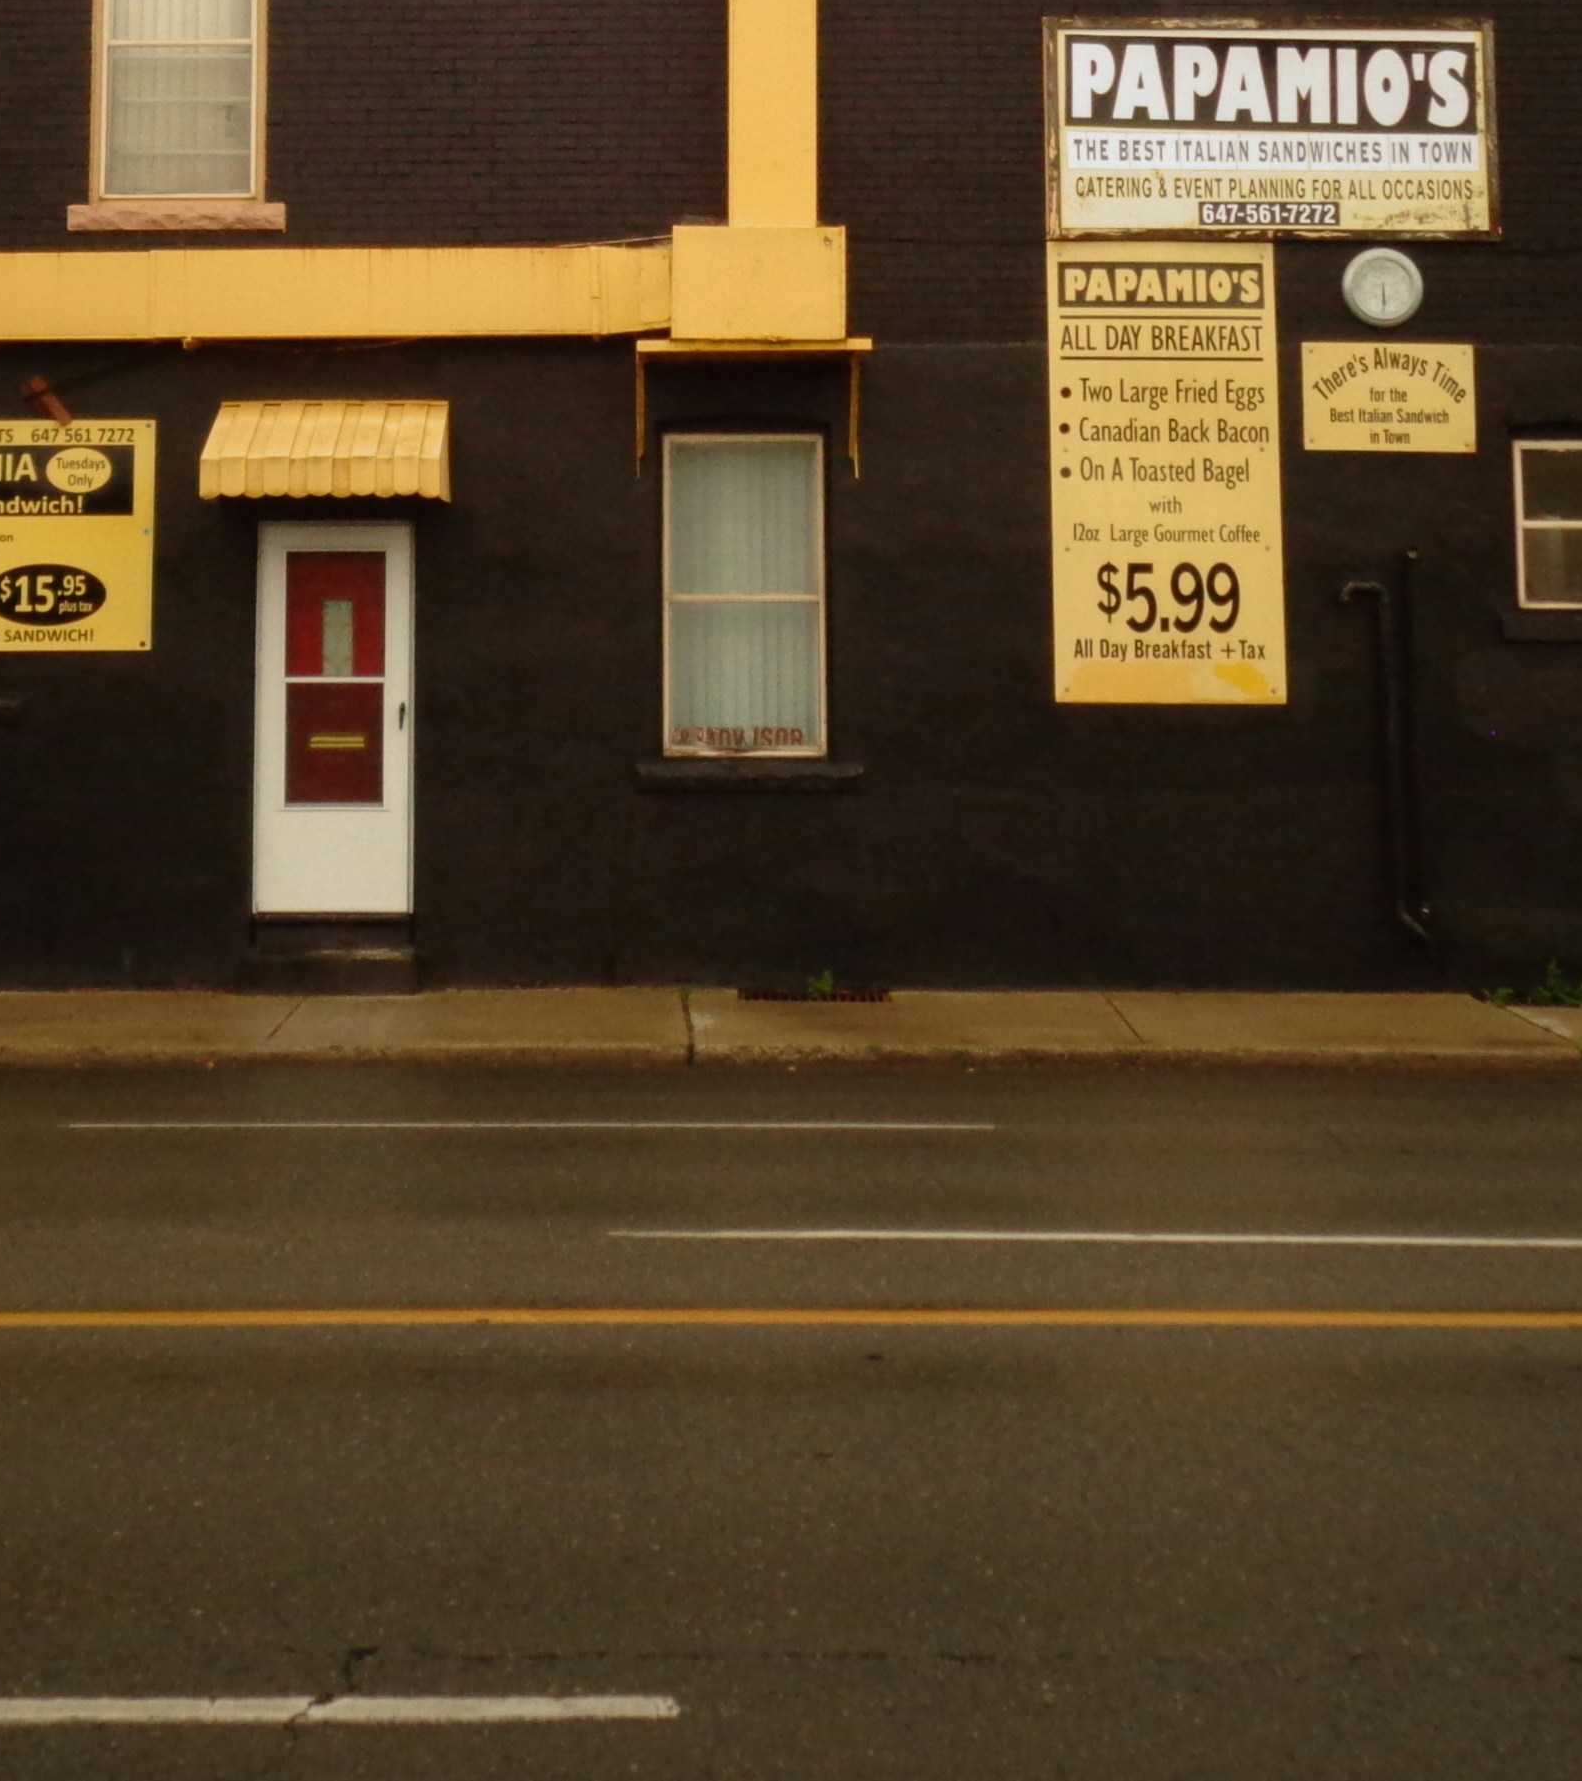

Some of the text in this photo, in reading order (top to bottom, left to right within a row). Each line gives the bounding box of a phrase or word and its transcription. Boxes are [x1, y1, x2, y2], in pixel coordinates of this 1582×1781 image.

[1070, 42, 1470, 127] PAPAMIO'S
[1073, 139, 1473, 163] THE BEST ITALIAN SANDWICHES IN TOWN
[1075, 176, 1473, 200] CATERING & EVENT PLANNING FOR ALL OCCASIONS
[1202, 203, 1336, 224] 647-561-7272
[1064, 269, 1261, 303] PAPAMIO'S
[1061, 326, 1263, 352] ALL DAY BREAKFAST
[1312, 347, 1467, 404] There's Always Time
[1079, 378, 1266, 410] Two Large Fried Eggs
[1369, 387, 1408, 402] for the
[1330, 407, 1449, 424] Best Italian Sandwich
[31, 428, 59, 442] 647
[64, 428, 92, 442] 561
[99, 428, 135, 442] 7272
[1079, 416, 1270, 444] Canadian Back Bacon
[1369, 429, 1410, 444] in Town
[56, 457, 106, 472] Tuesdays
[1080, 457, 1250, 489] On A Toasted Bagel
[67, 474, 93, 489] Only
[1149, 496, 1182, 515] with
[1073, 523, 1261, 547] 12oz Large Gourmet Coffee
[58, 601, 94, 614] plus tax
[1097, 561, 1240, 633] $5.99
[4, 629, 95, 643] SANDWICH!
[1074, 639, 1093, 658] All
[1099, 640, 1128, 662] Day
[1134, 639, 1212, 659] Breakfast
